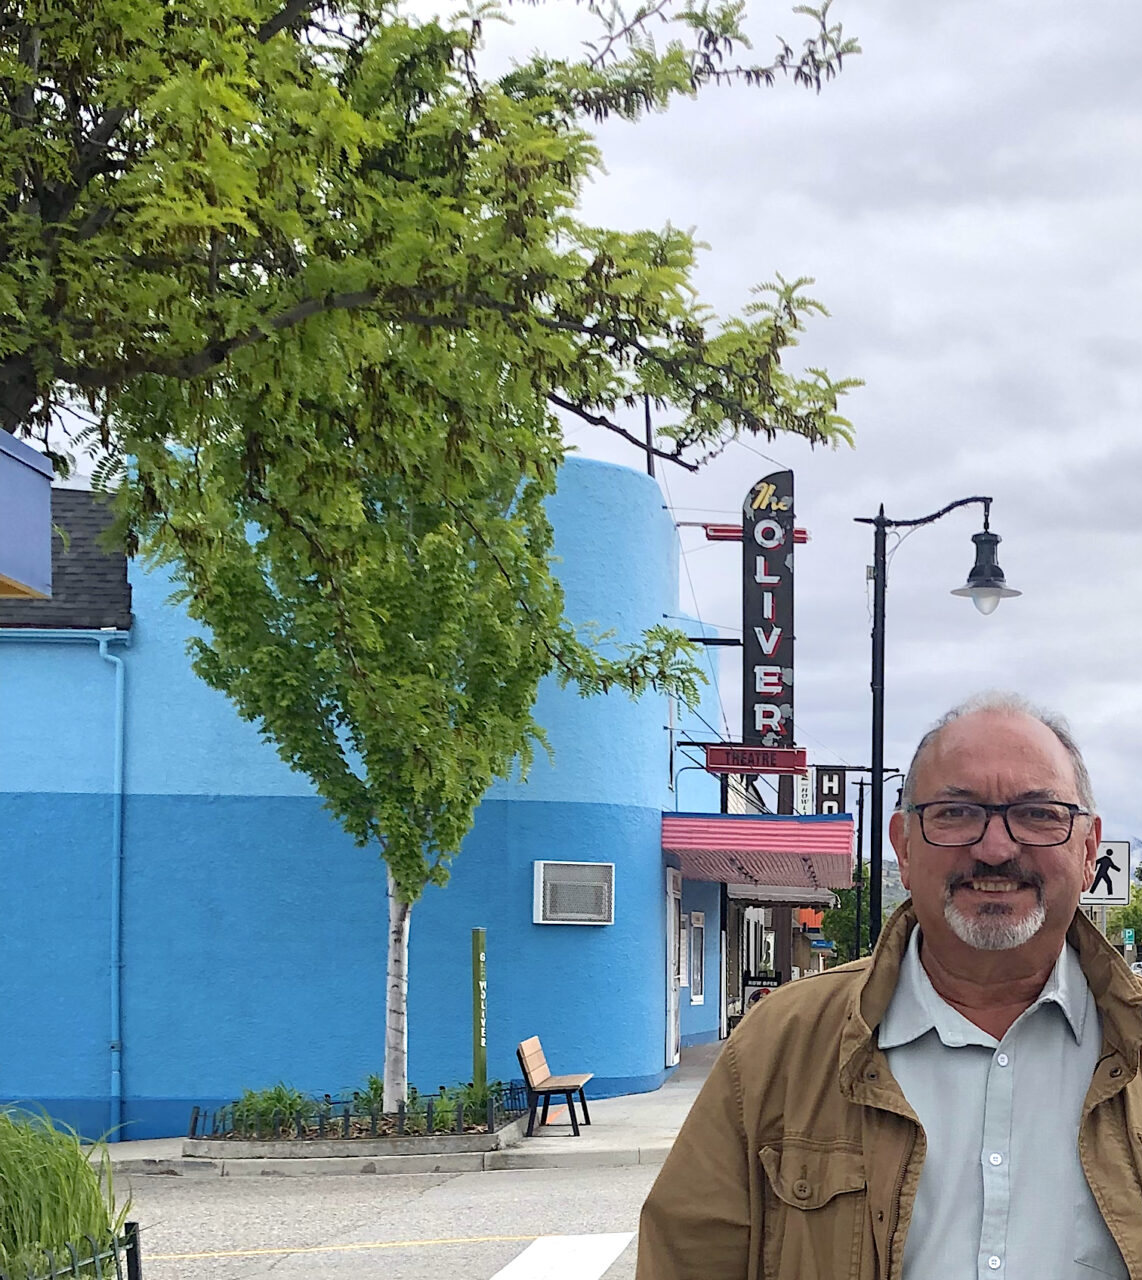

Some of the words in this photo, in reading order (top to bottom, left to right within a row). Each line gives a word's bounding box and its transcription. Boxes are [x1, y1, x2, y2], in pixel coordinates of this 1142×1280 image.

[753, 482, 789, 511] The
[753, 518, 785, 736] OLIVER
[725, 751, 777, 767] THEATRE
